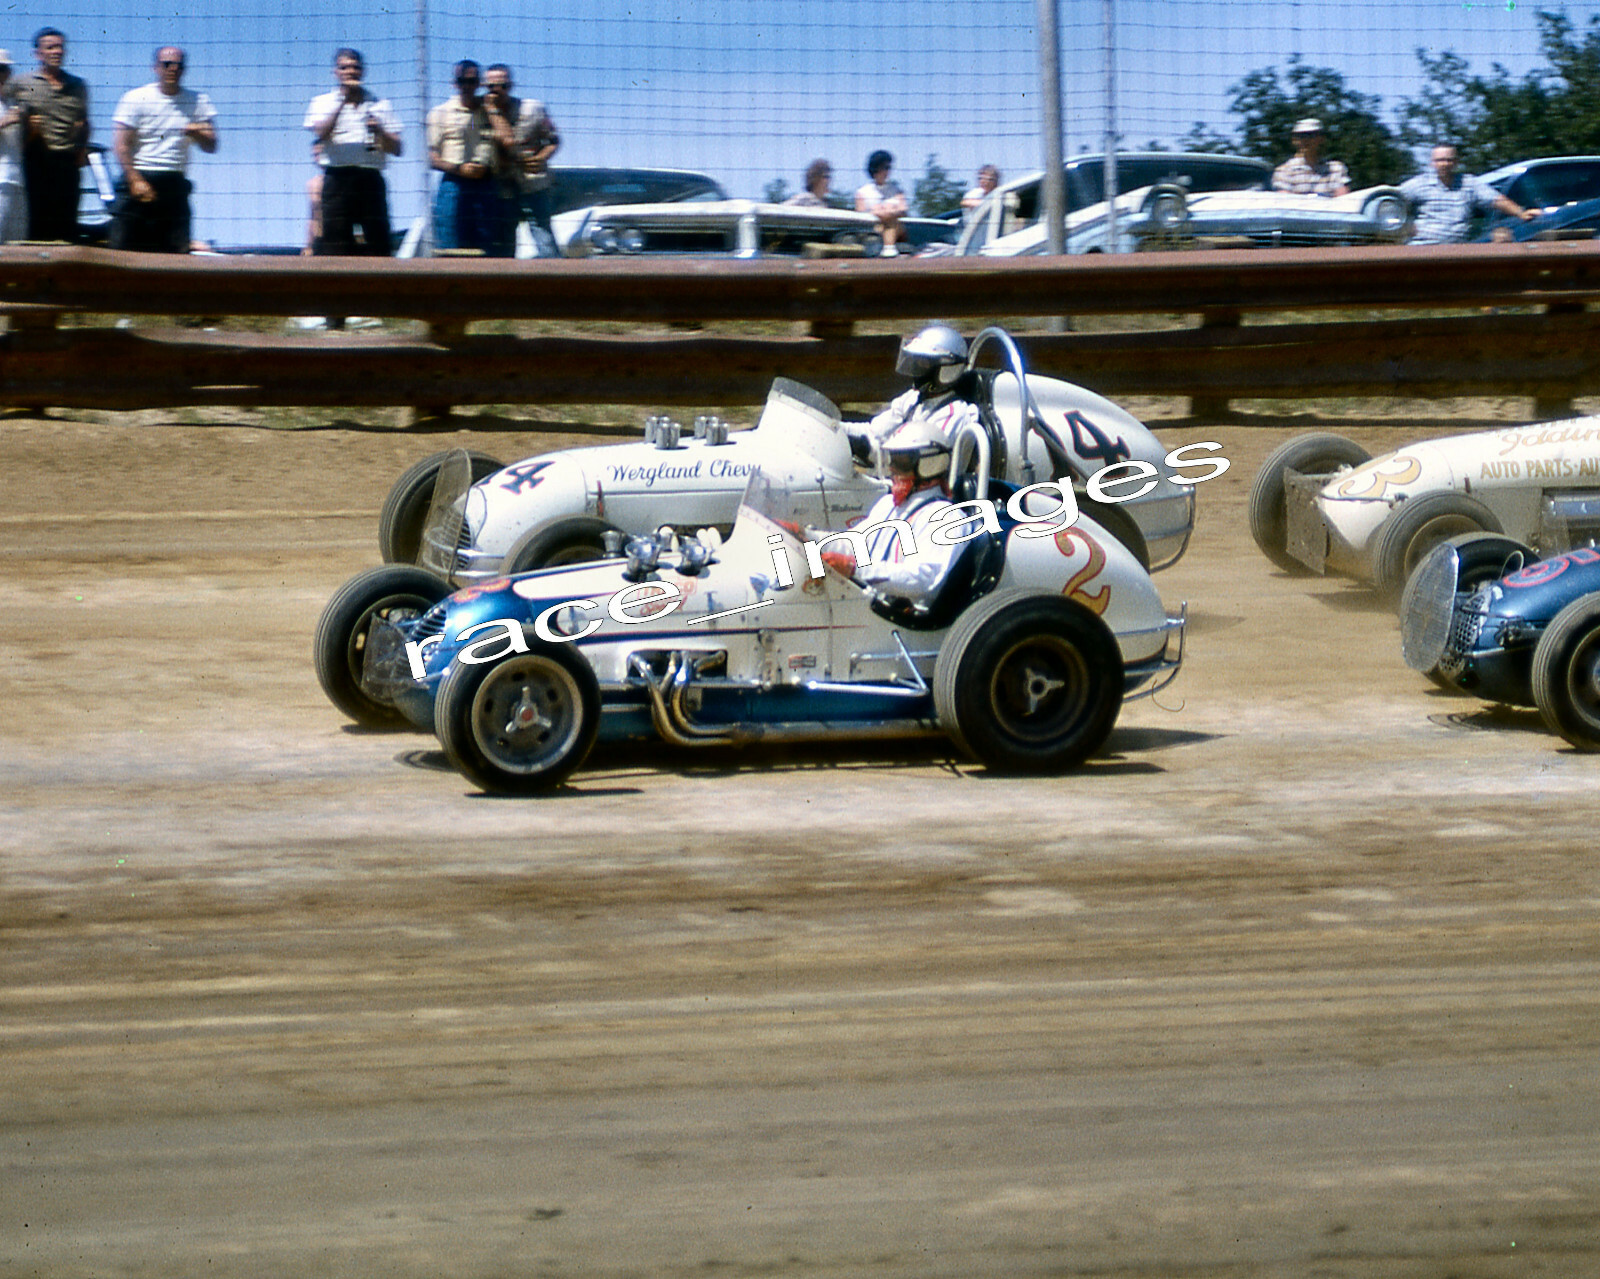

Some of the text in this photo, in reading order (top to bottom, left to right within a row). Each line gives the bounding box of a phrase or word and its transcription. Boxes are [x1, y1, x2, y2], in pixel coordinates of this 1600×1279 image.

[1032, 410, 1131, 483] 14
[1480, 461, 1521, 479] AUTO
[1579, 457, 1600, 476] AU
[606, 460, 703, 487] Wergland
[1054, 526, 1112, 616] 2
